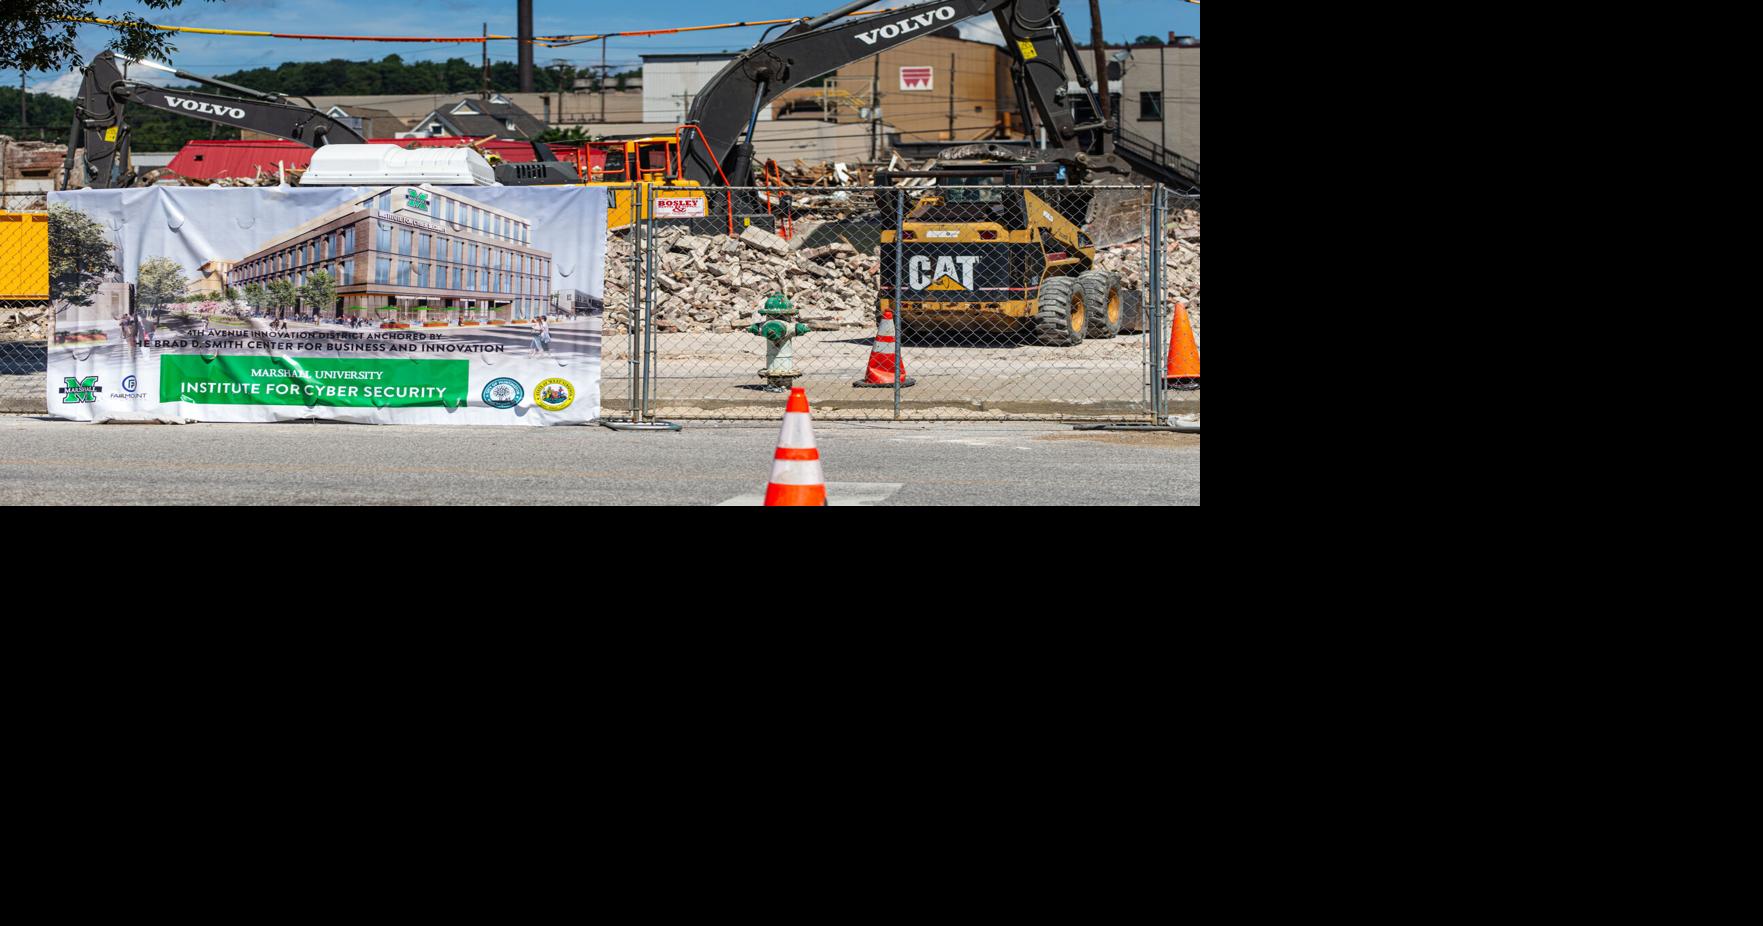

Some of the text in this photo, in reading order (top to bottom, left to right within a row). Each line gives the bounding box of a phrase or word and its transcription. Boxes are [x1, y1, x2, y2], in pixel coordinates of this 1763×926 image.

[854, 6, 956, 46] VOLVO
[164, 95, 246, 119] VOLVO
[909, 254, 975, 291] CAT
[208, 330, 249, 338] AVENUE
[251, 331, 315, 339] INNOVATION
[318, 332, 363, 340] DISTRICT
[367, 333, 427, 341] ANCHORED
[134, 340, 150, 348] HE
[154, 340, 188, 348] BRAD
[205, 341, 243, 349] SMITH
[247, 341, 292, 350] CENTER
[297, 342, 322, 351] FOR
[327, 343, 386, 352] BUSINESS
[389, 344, 417, 352] AND
[421, 344, 504, 353] INNOVATION
[251, 368, 383, 380] MARSHALL UNIVERSITY
[181, 382, 447, 398] INSTITUTE FOR CYBER SECURITY
